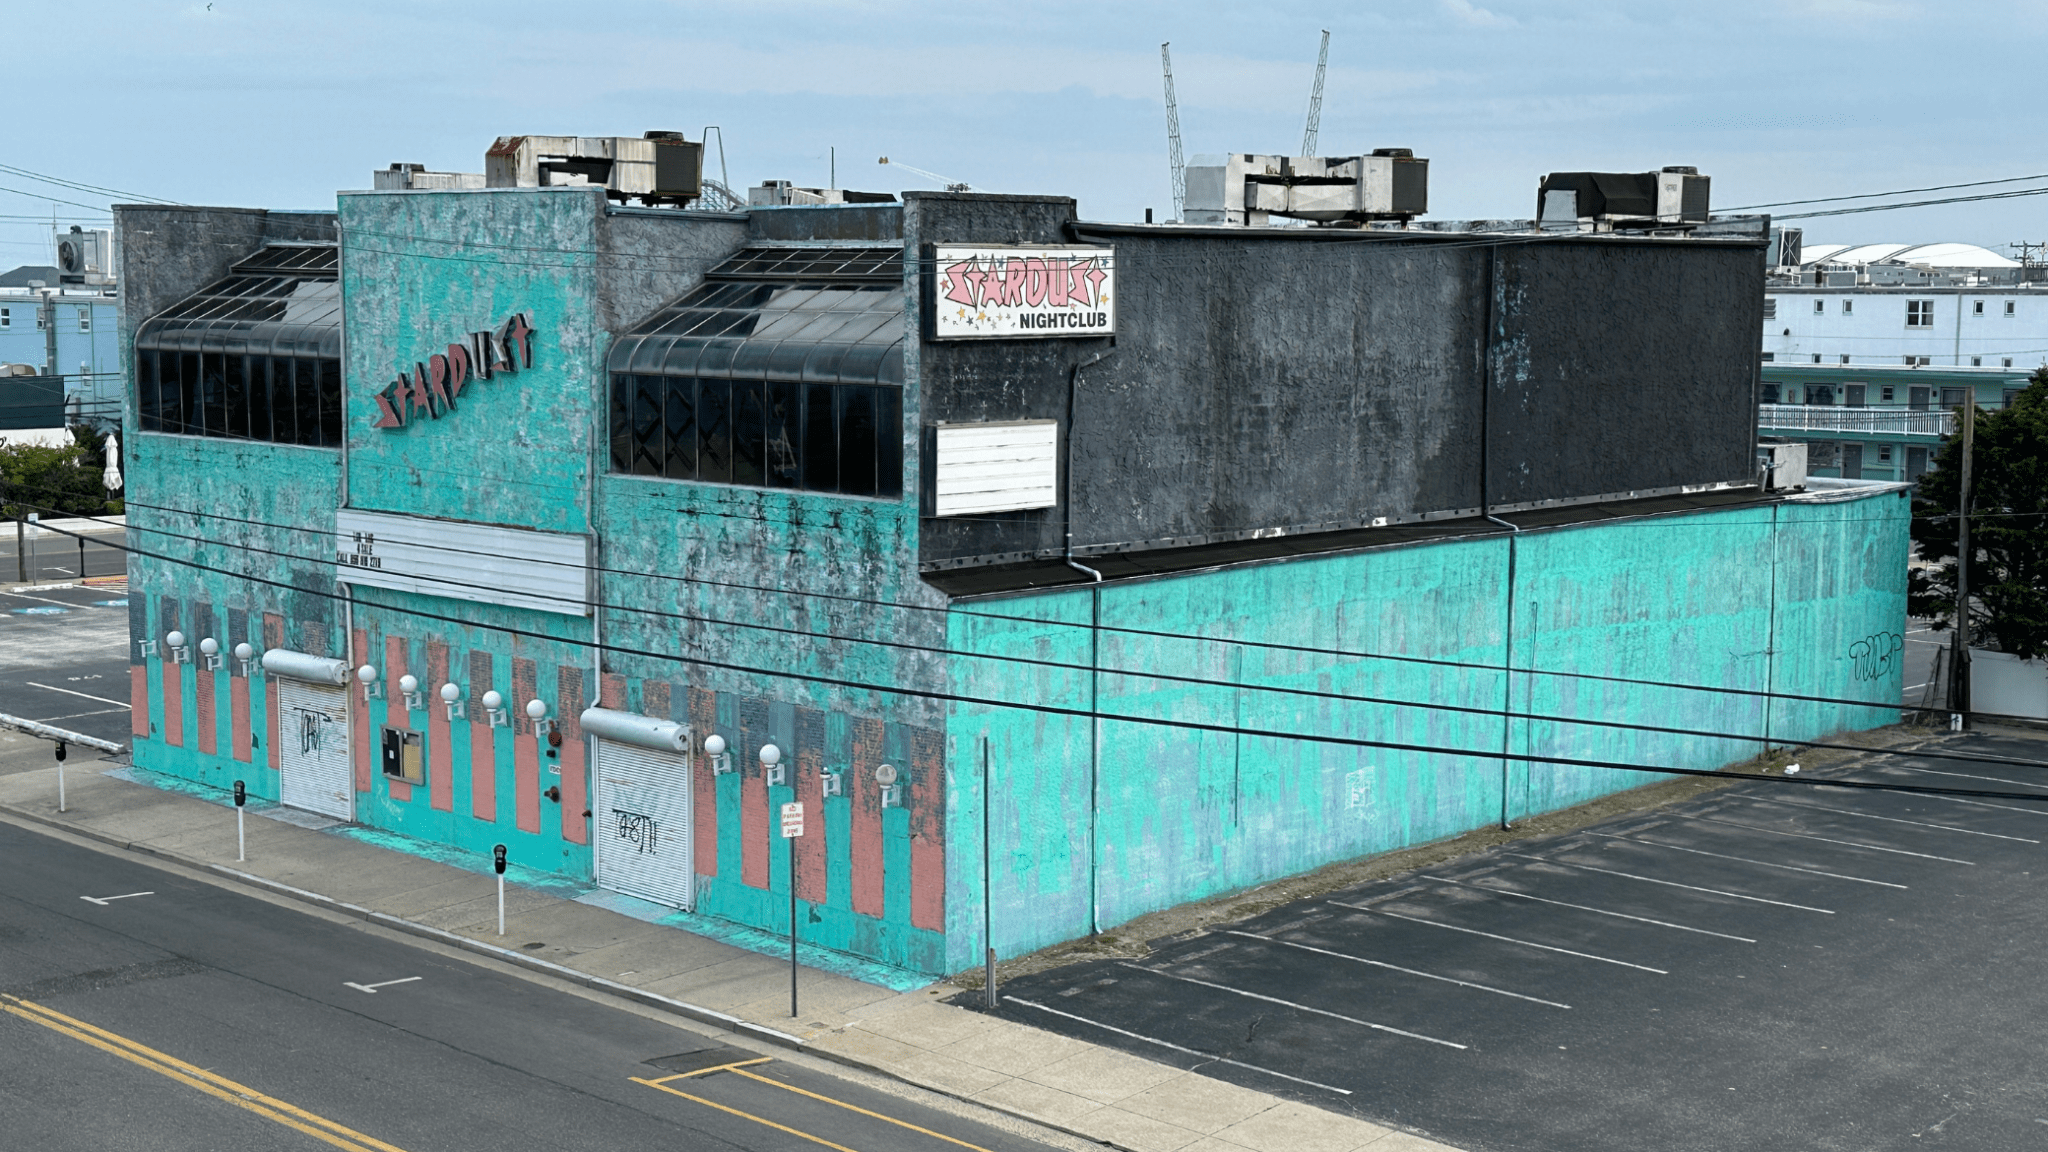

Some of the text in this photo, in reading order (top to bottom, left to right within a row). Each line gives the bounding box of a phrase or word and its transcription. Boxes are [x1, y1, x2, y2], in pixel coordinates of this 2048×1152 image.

[945, 254, 1108, 310] STARDUST
[1020, 312, 1107, 329] NIGHTCLUB
[373, 313, 536, 429] STARDUST
